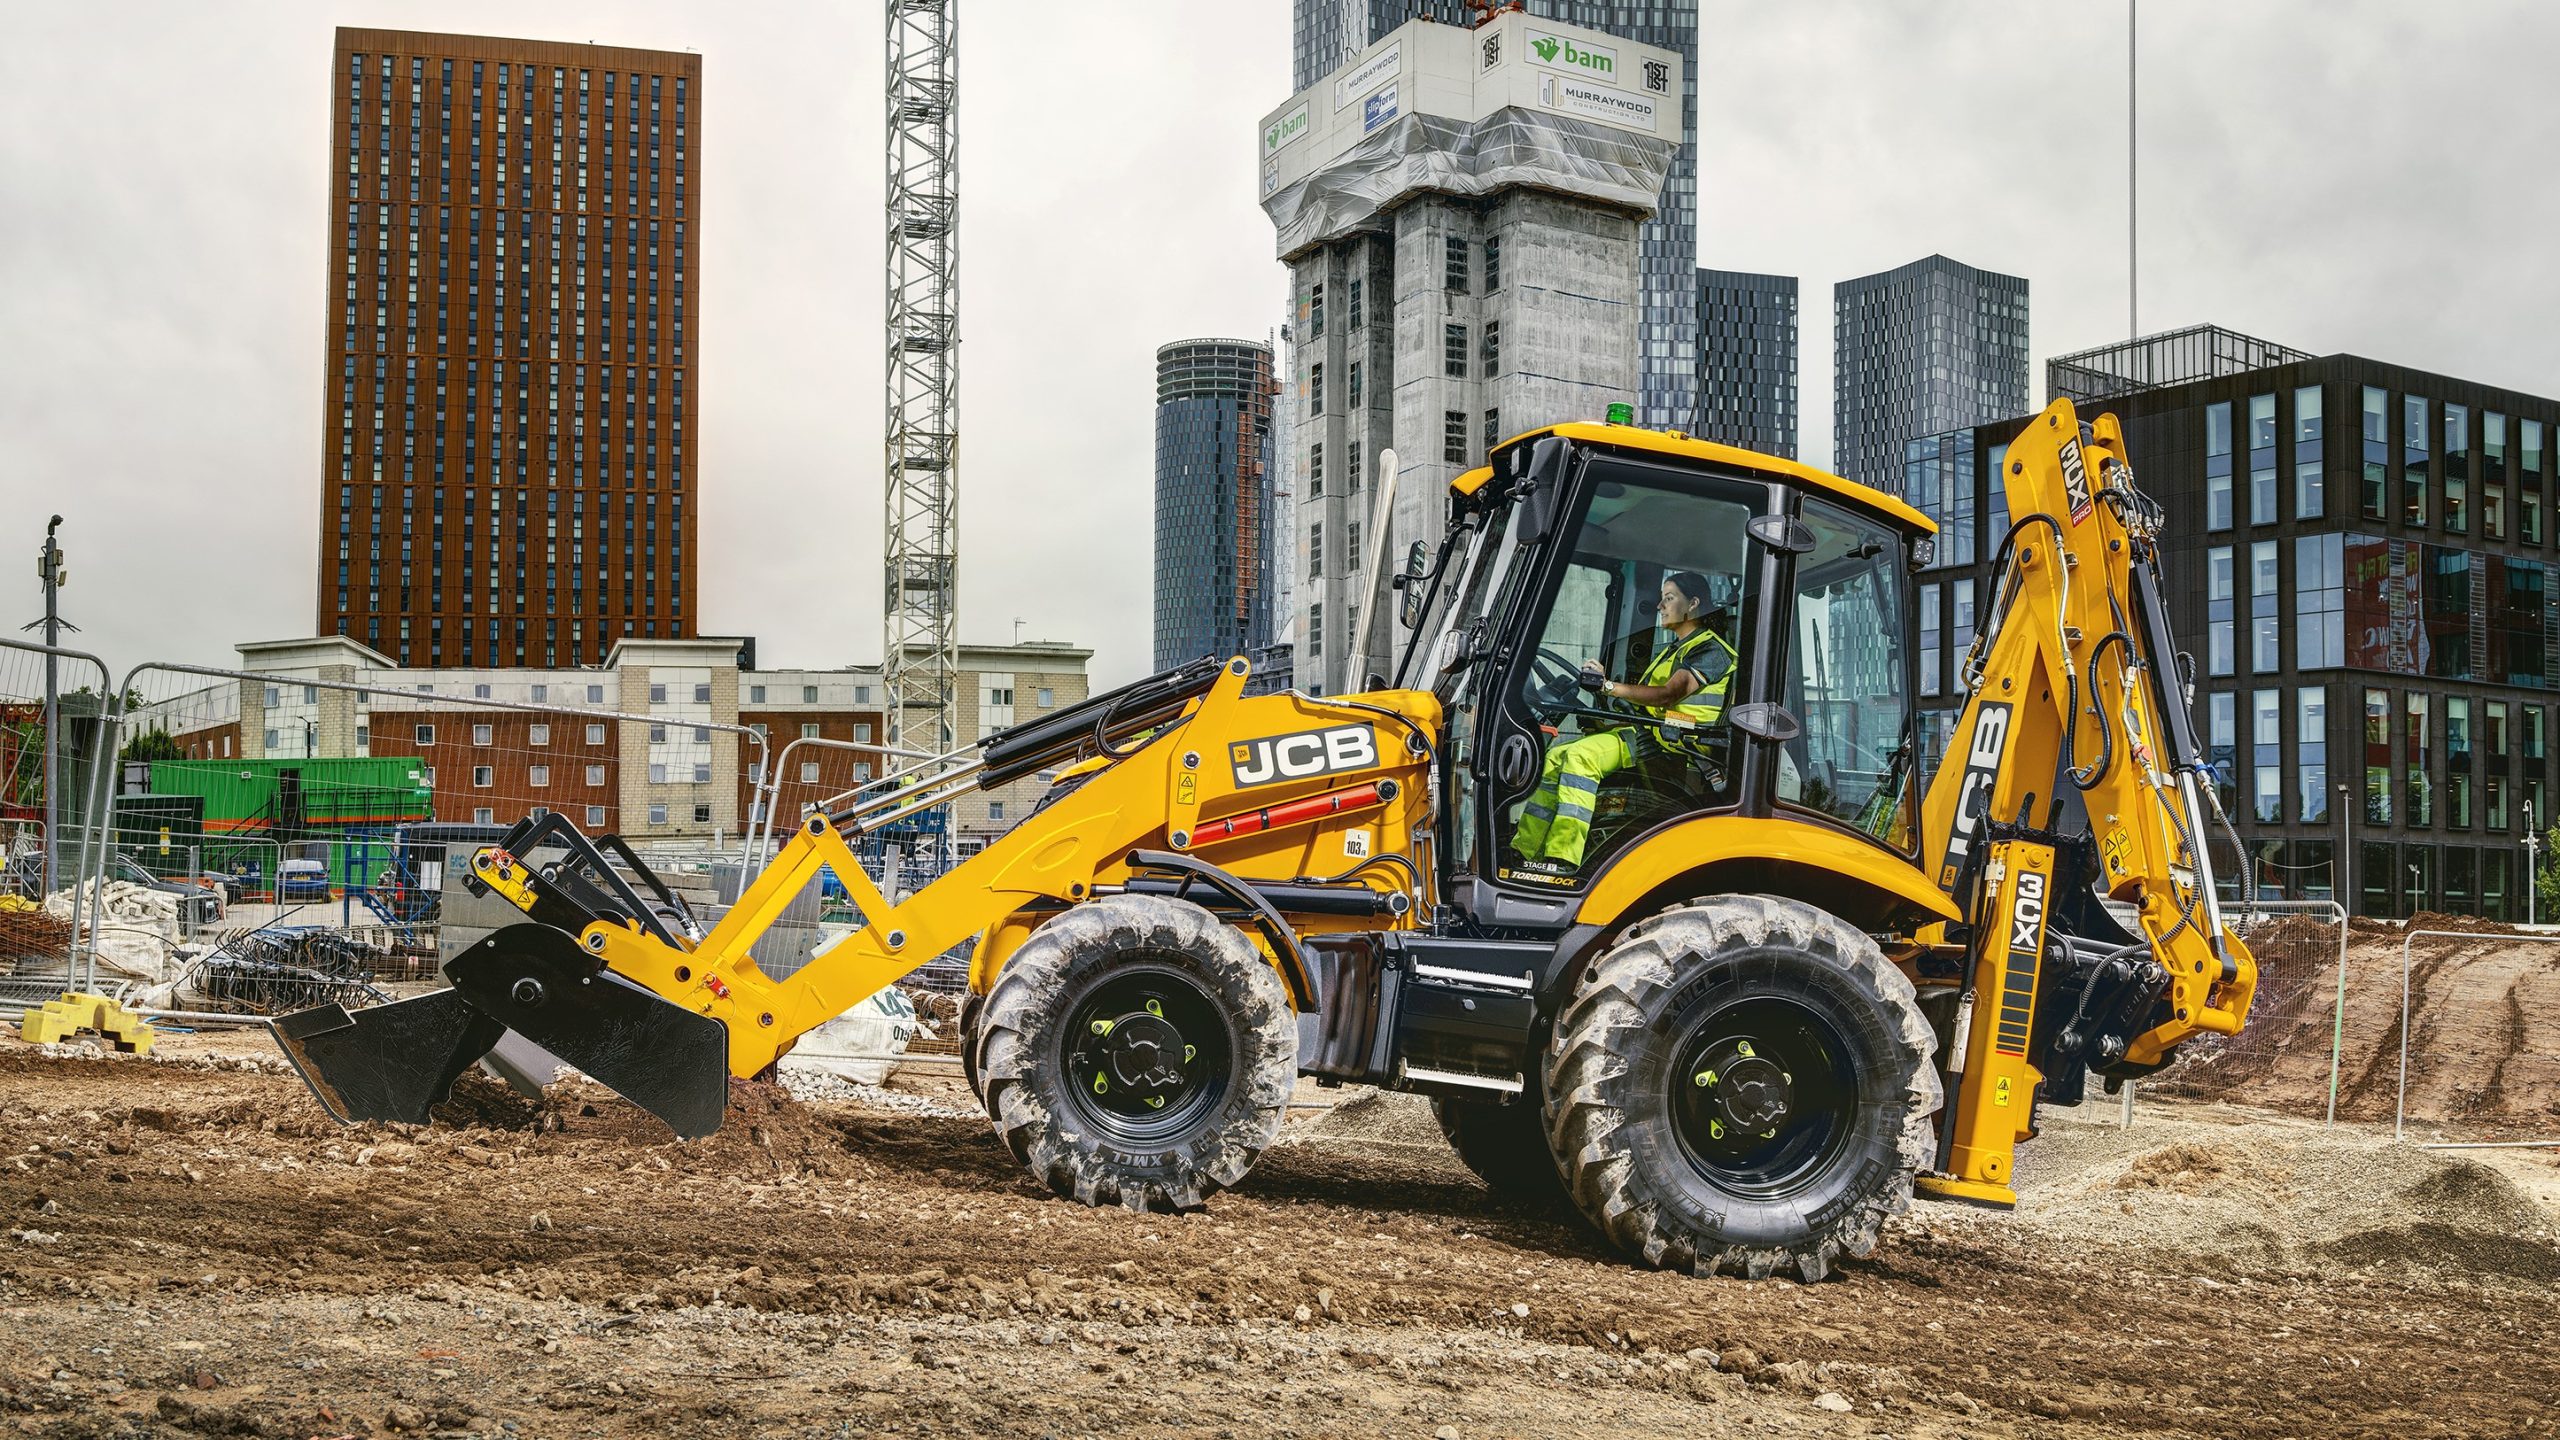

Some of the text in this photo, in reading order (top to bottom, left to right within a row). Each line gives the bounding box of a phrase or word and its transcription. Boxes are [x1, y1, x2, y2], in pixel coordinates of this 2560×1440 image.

[1564, 41, 1612, 73] bam
[1349, 52, 1399, 89] MURRAYWOOD
[1367, 91, 1396, 115] slipform
[1565, 88, 1652, 115] MURRAYWOOD
[1573, 101, 1630, 118] CONSTRUCTION
[1282, 112, 1306, 138] bam
[2060, 440, 2090, 511] 3CX
[2073, 504, 2092, 526] PRO
[1236, 726, 1376, 784] JCB
[1347, 840, 1362, 856] 103
[1523, 861, 1547, 870] STAGE
[1511, 871, 1577, 886] TORQUELOCK
[2011, 873, 2043, 947] 3CX
[1111, 1150, 1163, 1167] XMCL
